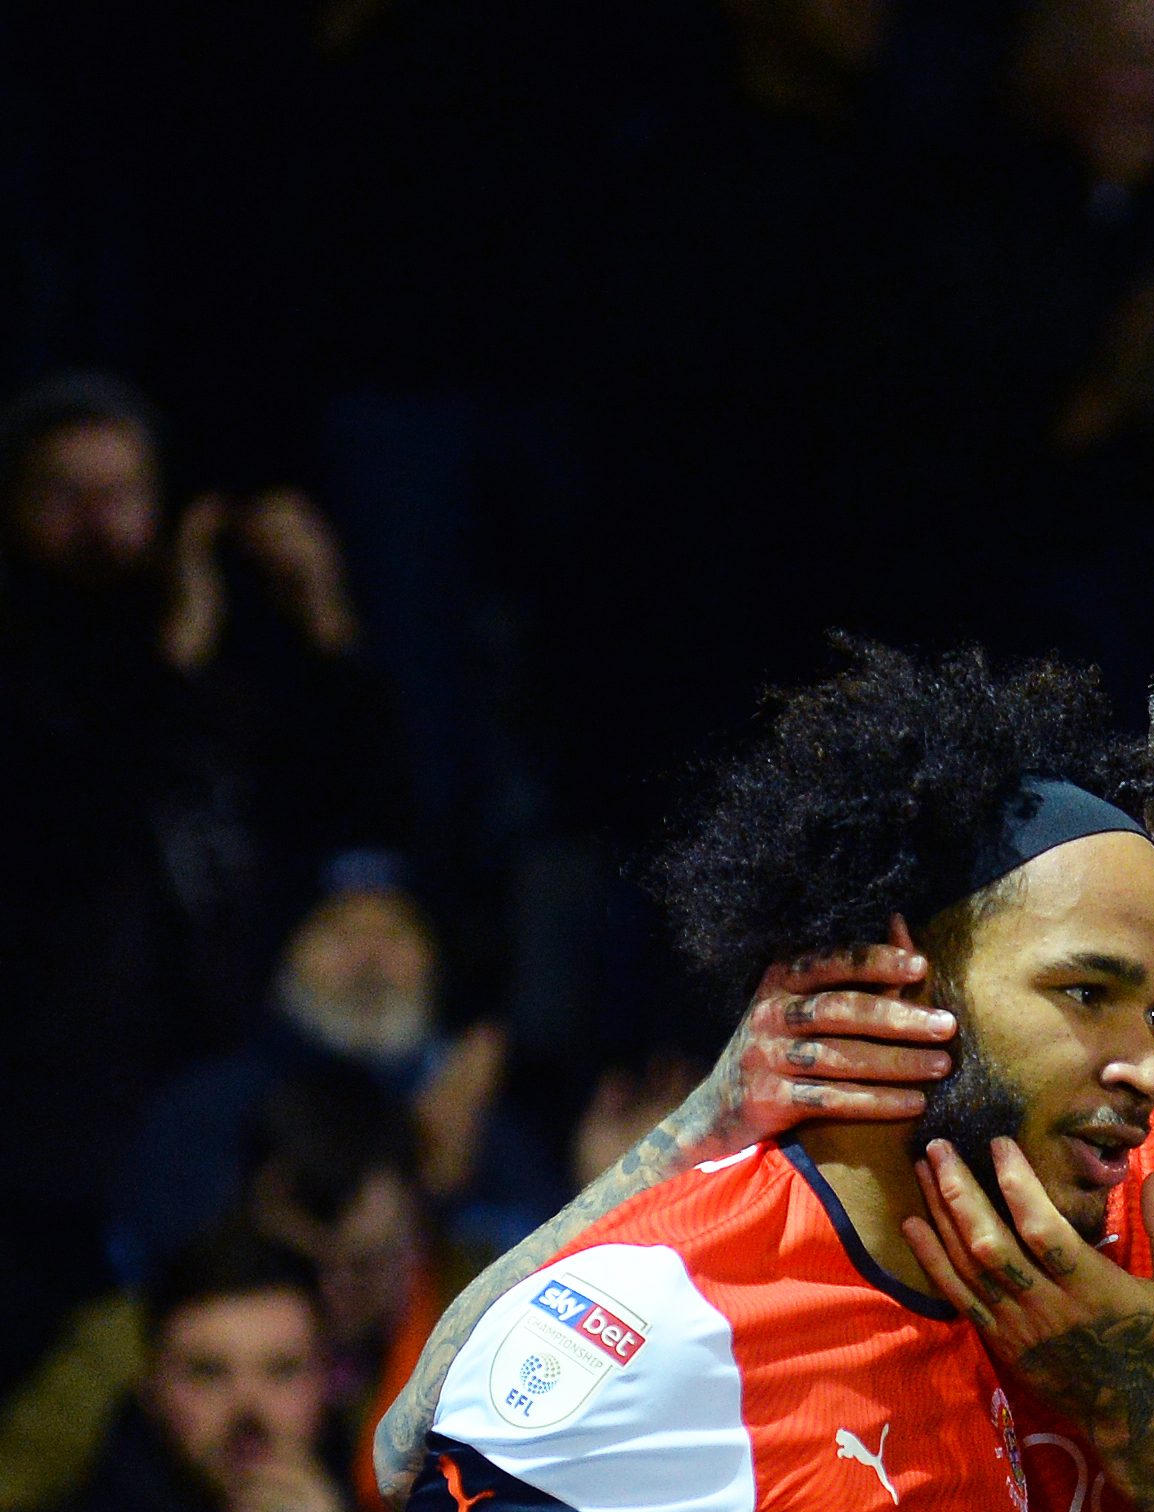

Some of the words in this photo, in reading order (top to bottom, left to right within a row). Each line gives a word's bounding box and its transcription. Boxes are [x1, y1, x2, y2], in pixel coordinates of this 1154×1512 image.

[526, 1314, 604, 1369] CHAMPIONSHIP
[538, 1287, 586, 1321] sky
[582, 1306, 636, 1357] bet
[505, 1388, 534, 1418] EFL
